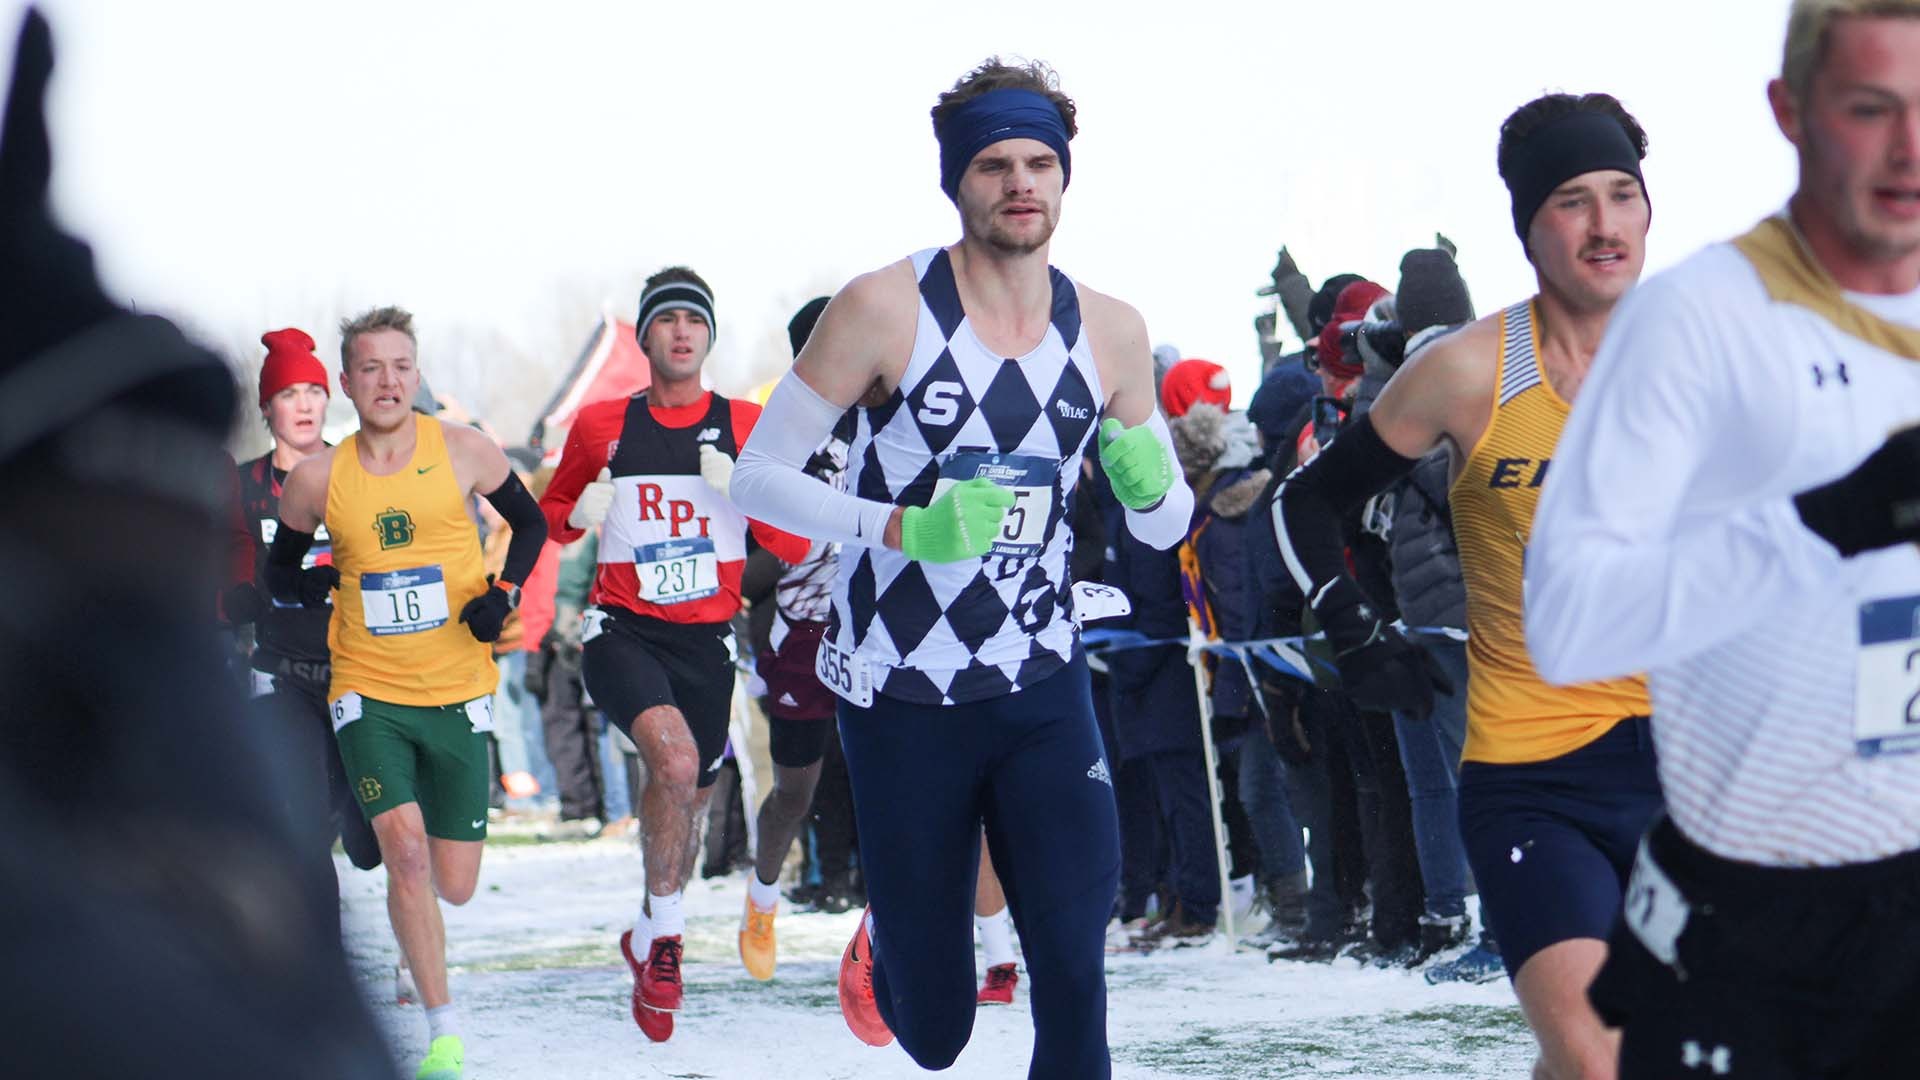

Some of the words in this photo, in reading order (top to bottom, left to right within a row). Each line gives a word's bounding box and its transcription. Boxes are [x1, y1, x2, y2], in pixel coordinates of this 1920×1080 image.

[916, 380, 964, 426] S
[1060, 405, 1089, 420] WIAC
[374, 508, 415, 551] B
[635, 483, 711, 538] RPI
[655, 558, 698, 595] 237
[388, 589, 422, 624] 16
[820, 639, 853, 694] 355
